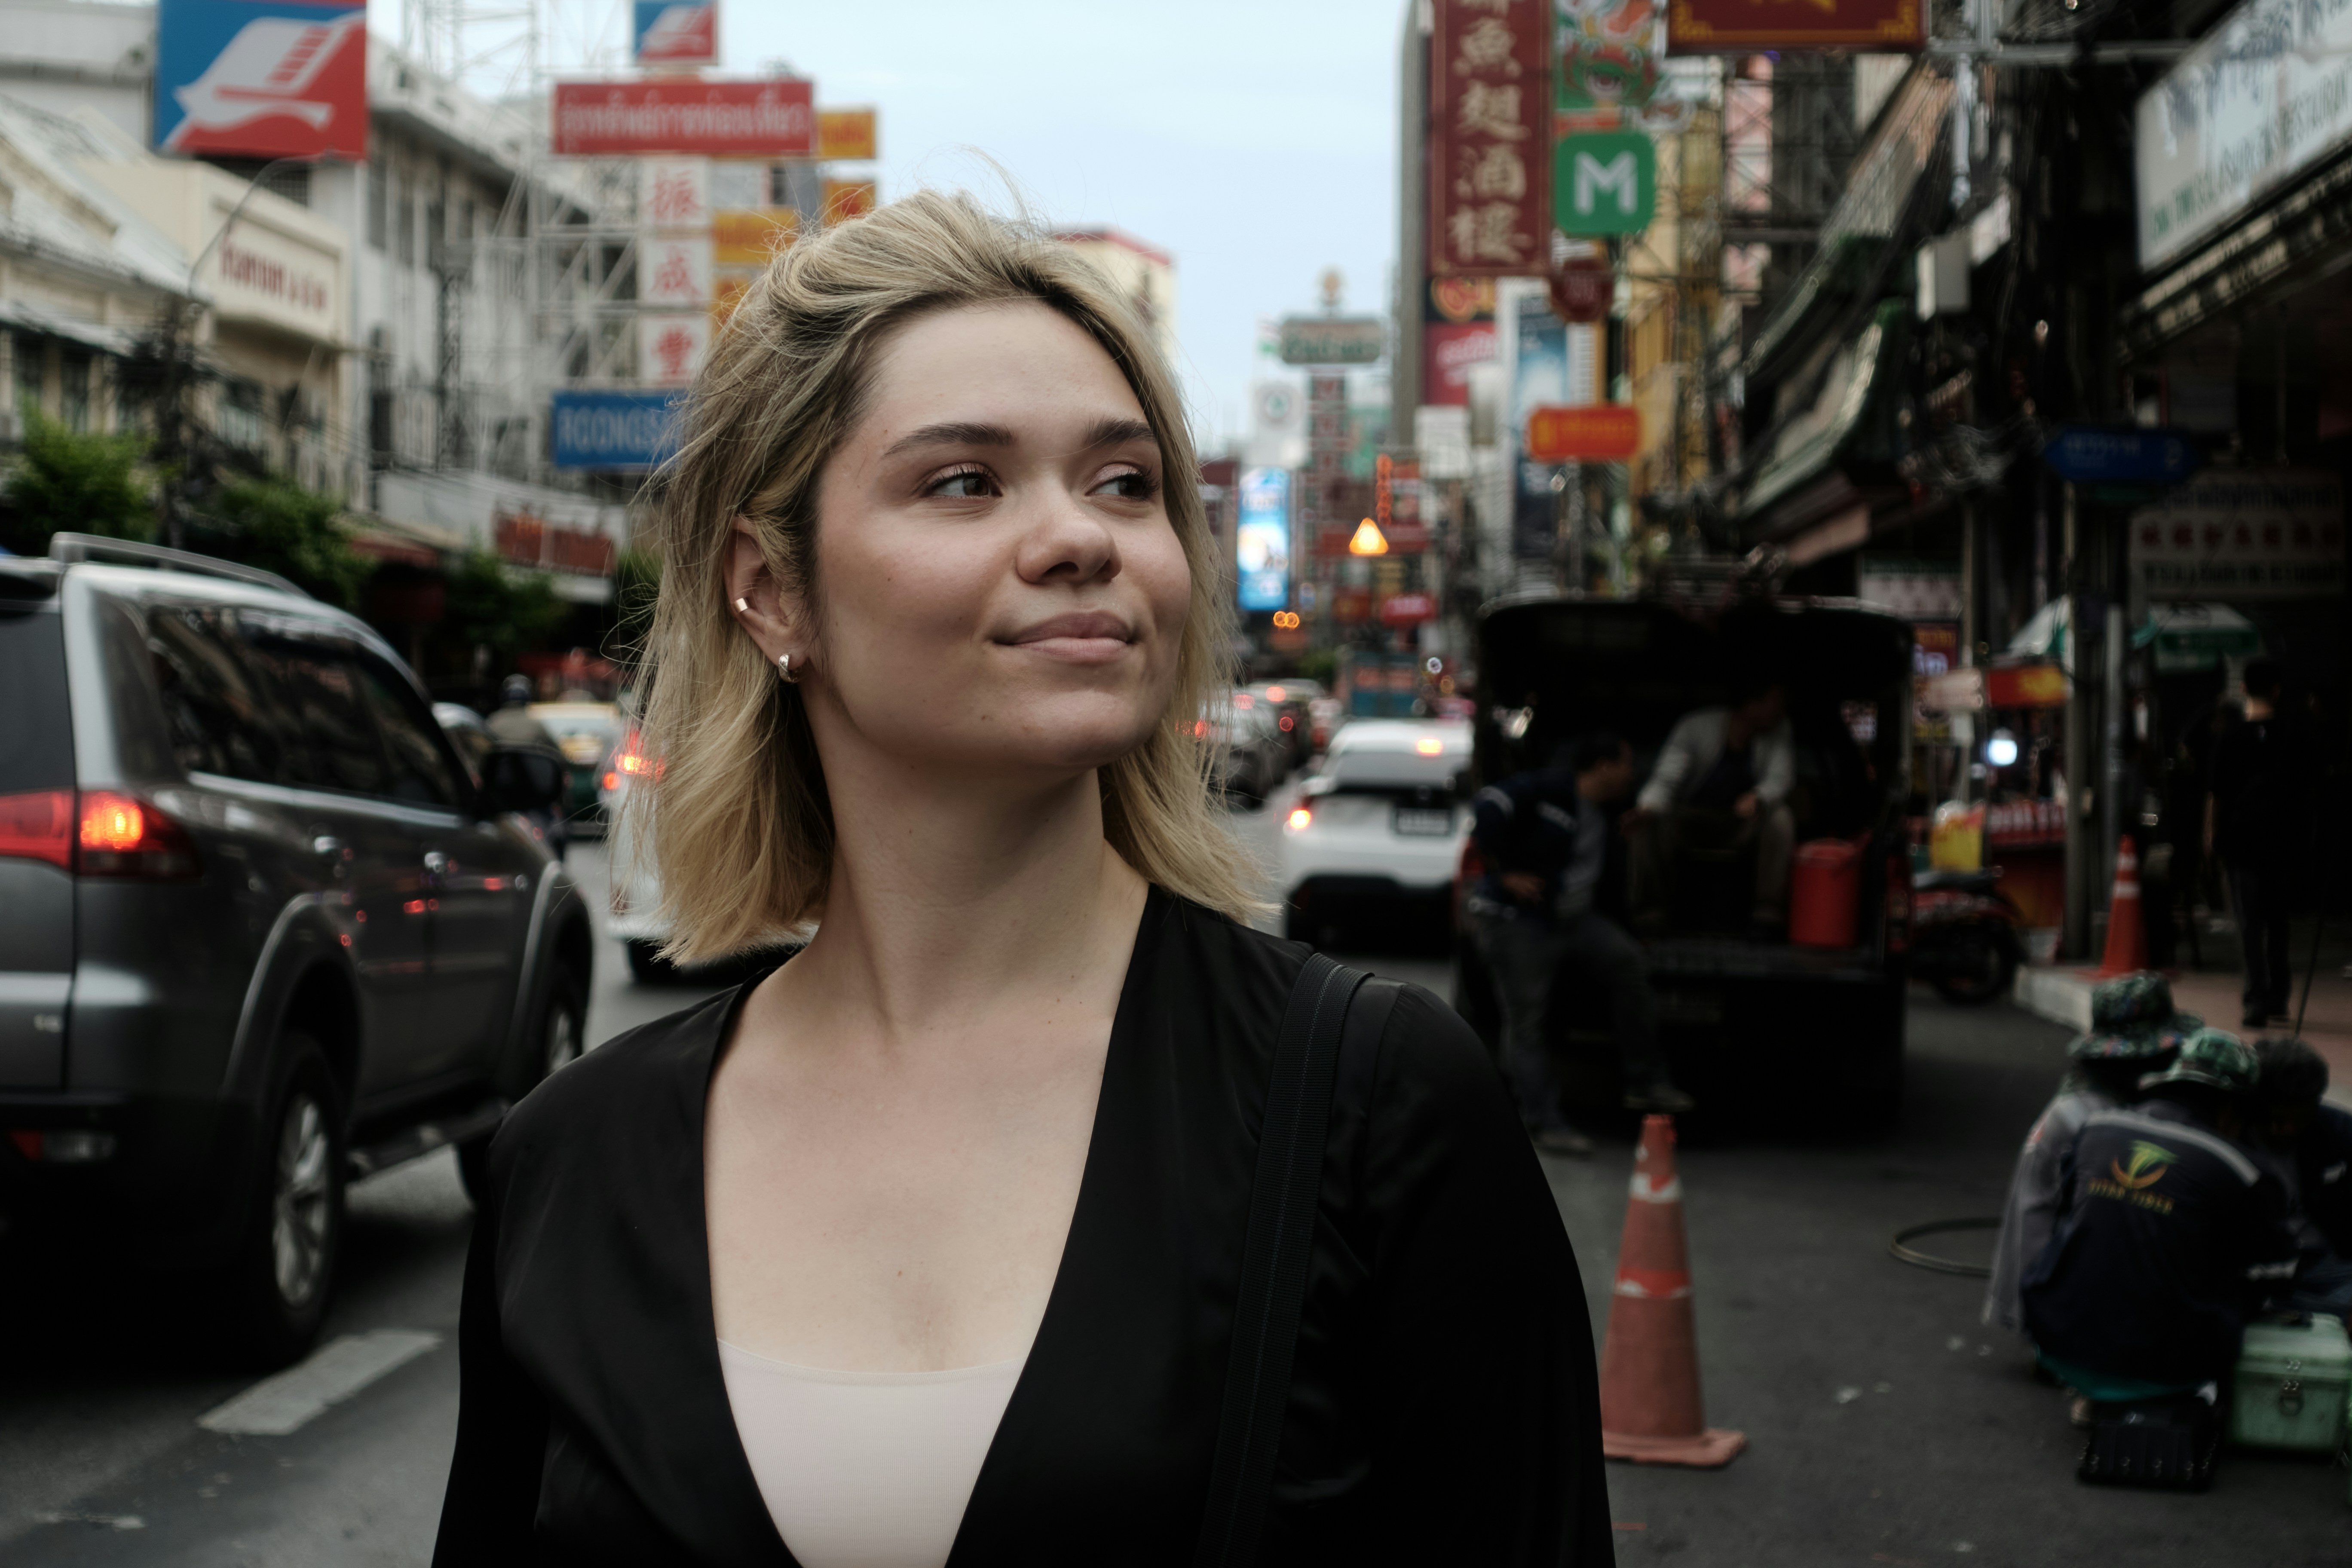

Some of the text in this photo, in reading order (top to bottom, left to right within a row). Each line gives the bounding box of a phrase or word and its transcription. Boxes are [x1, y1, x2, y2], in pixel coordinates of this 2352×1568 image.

[1448, 0, 1533, 262] 魚翅酒樓
[1573, 149, 1638, 216] M
